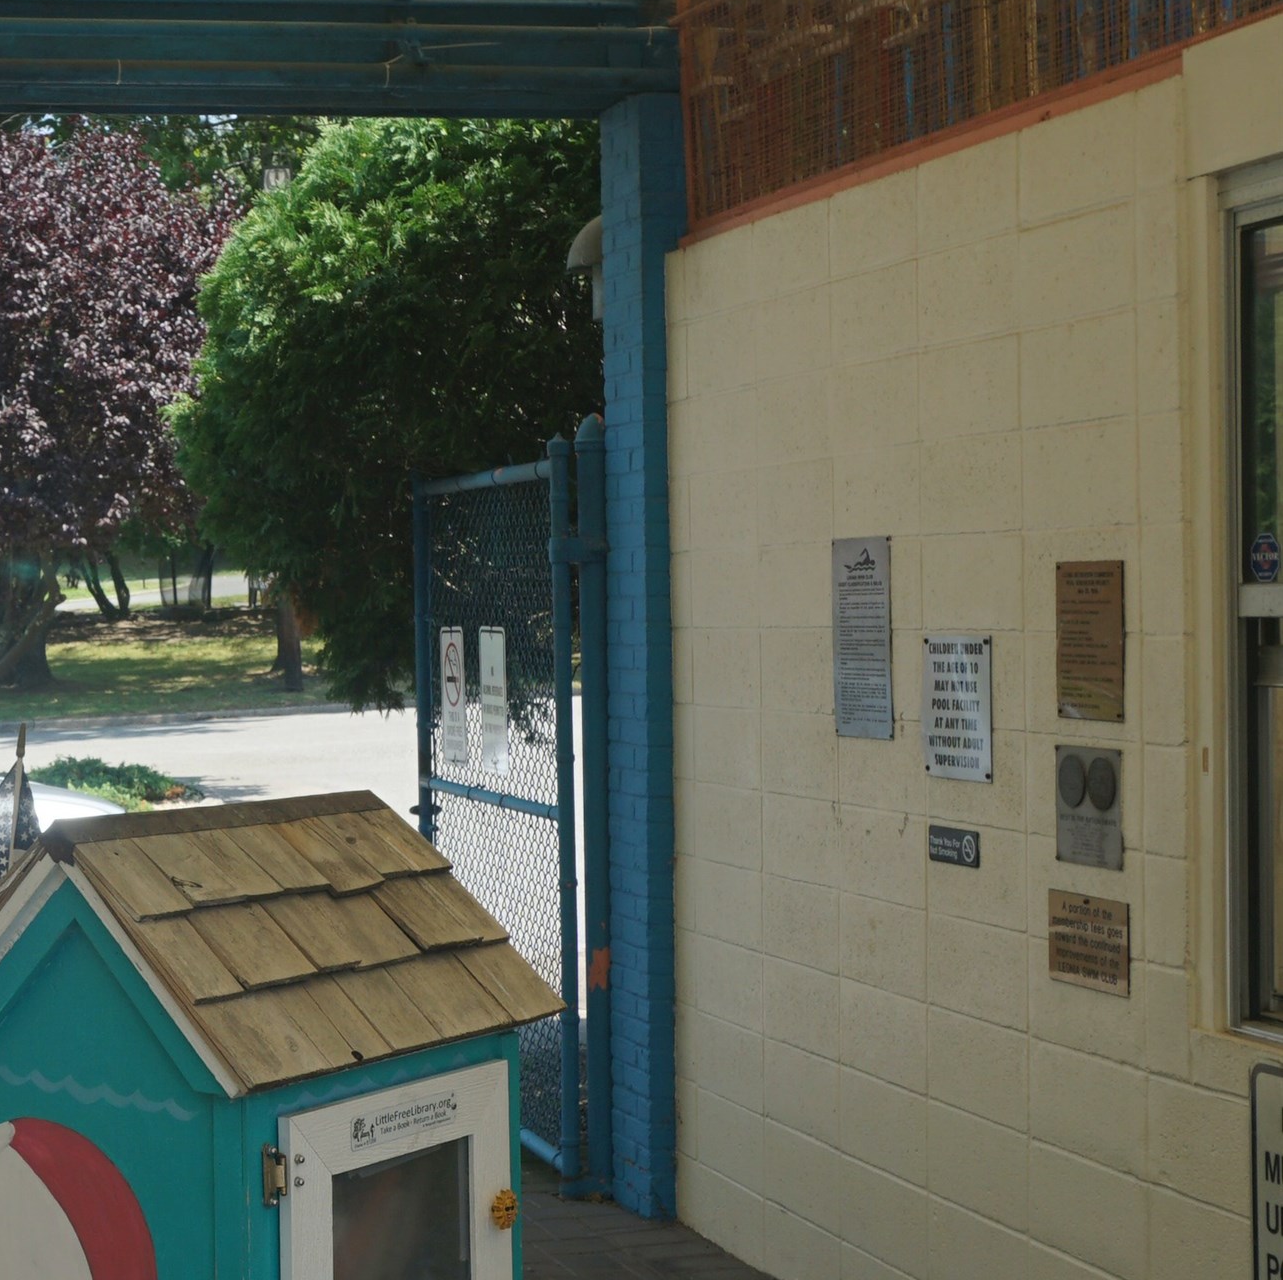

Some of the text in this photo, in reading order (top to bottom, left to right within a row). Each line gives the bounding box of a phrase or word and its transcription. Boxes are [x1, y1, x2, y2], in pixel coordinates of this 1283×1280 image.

[928, 642, 983, 655] CHILDREN UNDER
[933, 661, 979, 674] THE AGE OF 10
[934, 680, 978, 694] MAY NOT USE
[931, 698, 981, 713] POOL FACILITY
[934, 717, 978, 731] AT ANY TIME
[928, 735, 984, 751] WITHOUT ADULT
[934, 754, 980, 769] SUPERVISION
[938, 846, 958, 861] Smoking
[1062, 901, 1113, 920] A portion of the
[1052, 916, 1123, 940] membership fees goes
[1054, 931, 1121, 954] toward the continued
[1100, 955, 1108, 967] of
[1109, 956, 1120, 970] the
[1057, 961, 1118, 986] LEONIA SWIM CLUB
[375, 1098, 451, 1126] LittleFreeLibrary.org
[380, 1127, 392, 1135] Take
[397, 1121, 410, 1130] Book
[413, 1116, 430, 1125] Return
[434, 1111, 447, 1120] Book
[1264, 1150, 1283, 1185] M
[1265, 1201, 1283, 1236] U
